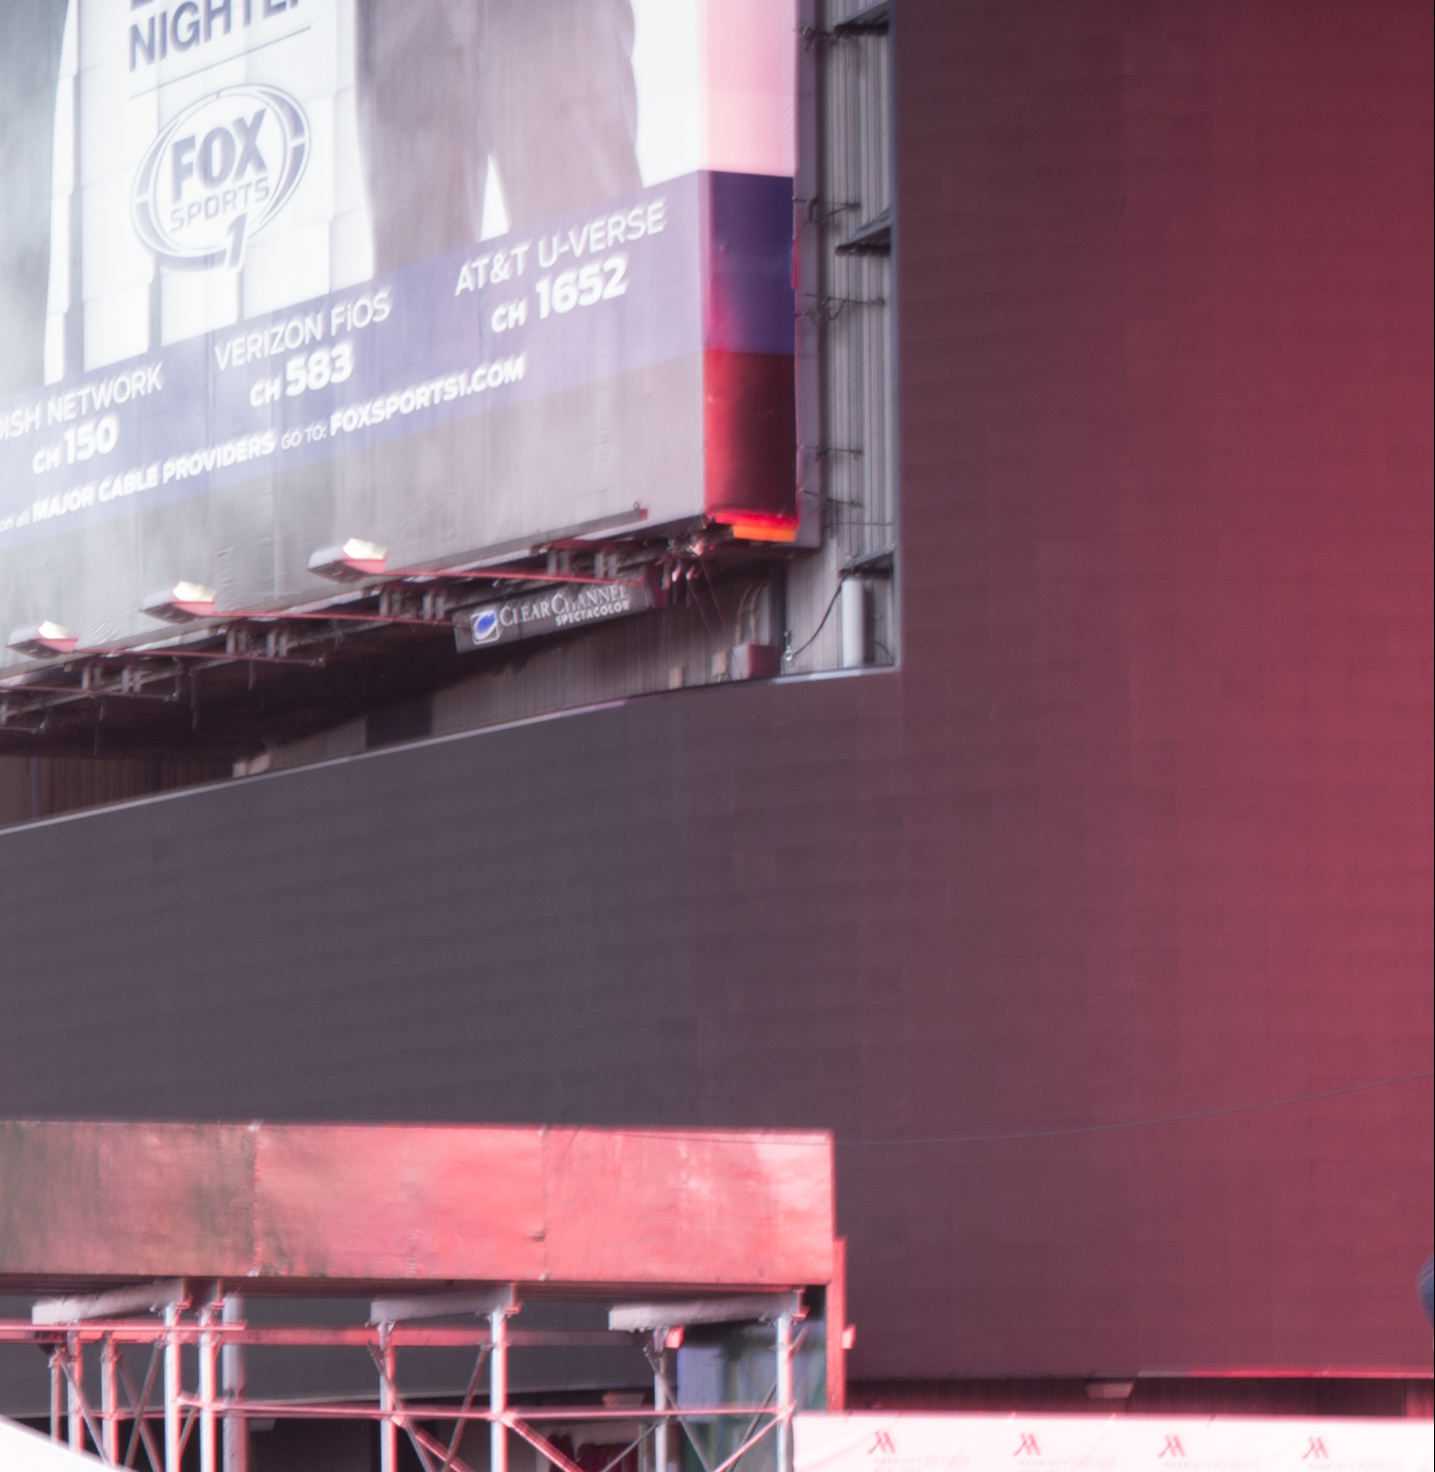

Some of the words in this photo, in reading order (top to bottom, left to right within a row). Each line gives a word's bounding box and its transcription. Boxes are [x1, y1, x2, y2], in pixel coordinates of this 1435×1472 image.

[171, 108, 268, 204] FOX
[170, 176, 270, 234] SPORTS
[226, 212, 248, 271] 1
[454, 246, 531, 297] AT&T
[536, 201, 669, 269] U-VERSE
[214, 325, 324, 373] VERIZON
[330, 286, 393, 338] FiOS
[490, 292, 529, 334] CH
[534, 257, 630, 322] 1652
[46, 358, 164, 428] NETWORK
[249, 373, 283, 408] CH
[284, 337, 356, 397] 583
[32, 485, 94, 524] MAJOR
[97, 459, 161, 501] CABLE
[162, 430, 277, 485] PROVIDERS
[281, 428, 303, 450] GO
[329, 354, 525, 437] FOXSPORTS1.COM
[32, 440, 64, 475] CH
[63, 412, 120, 466] 150
[554, 600, 631, 628] SPECTACOLOR
